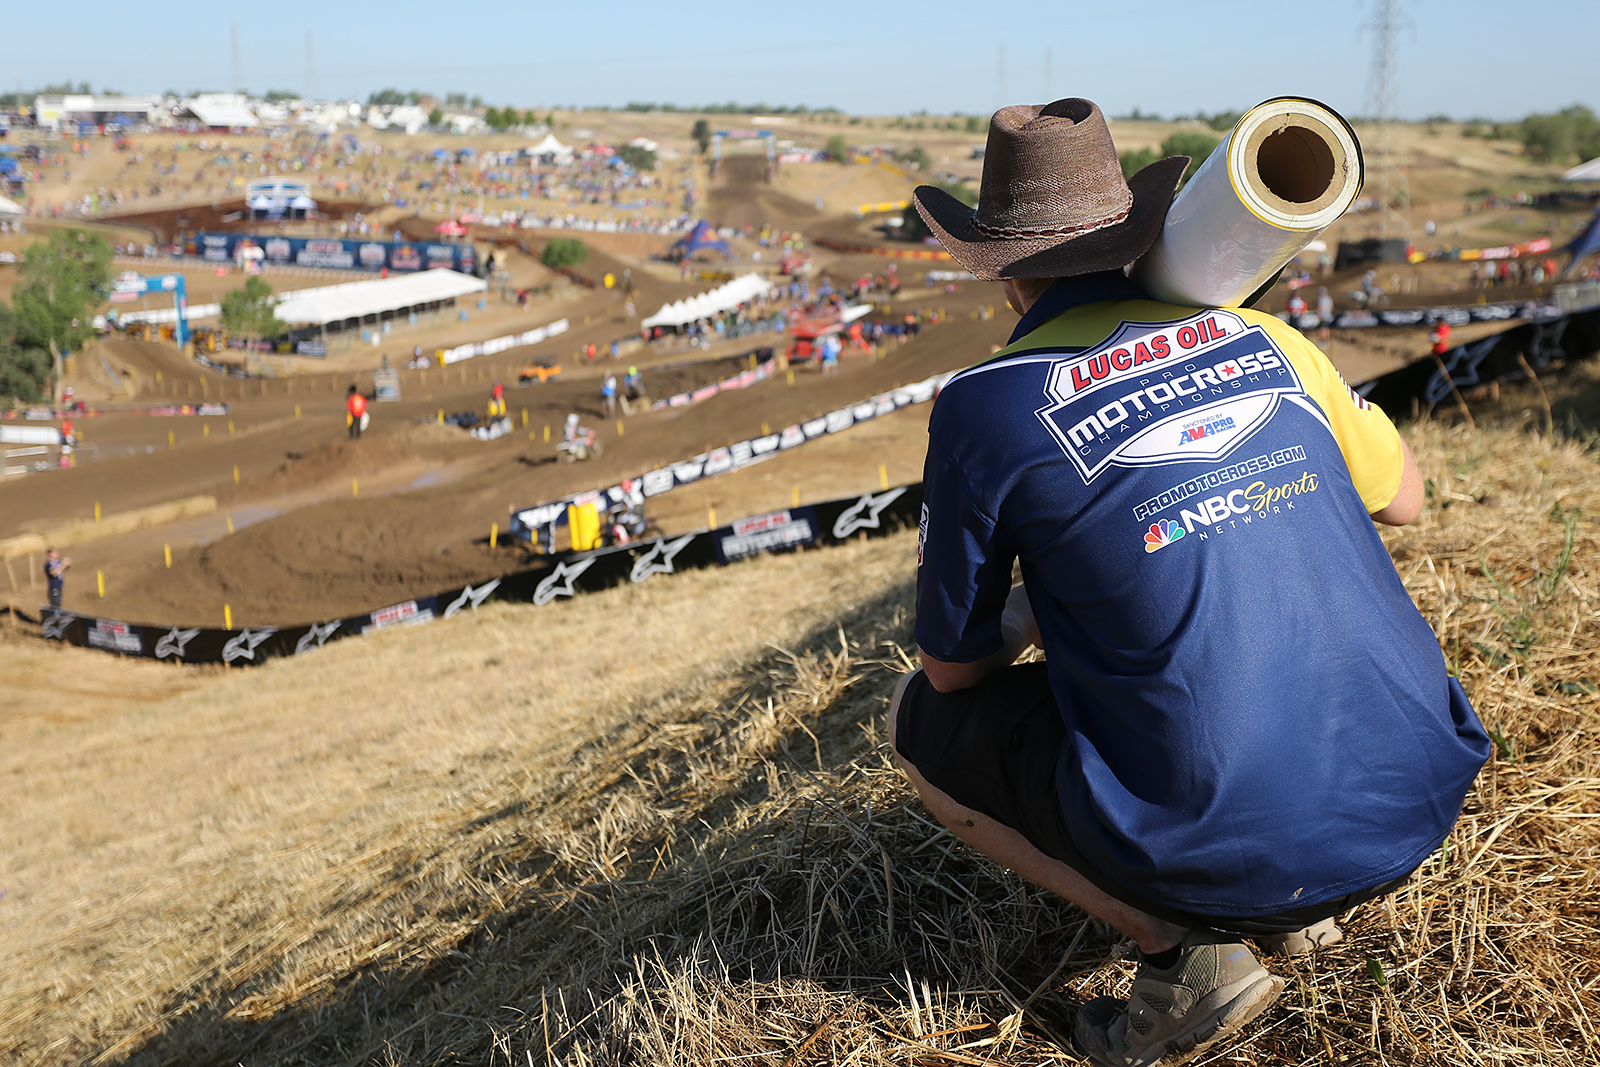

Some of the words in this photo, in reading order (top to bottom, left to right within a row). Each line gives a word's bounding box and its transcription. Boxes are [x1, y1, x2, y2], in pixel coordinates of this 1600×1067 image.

[1071, 334, 1171, 392] LUCAS
[1176, 317, 1227, 349] OIL
[1140, 363, 1198, 387] PRO
[1067, 349, 1282, 448] MOTOCROSS
[1081, 367, 1287, 457] CHAMPIONSHIP
[1183, 416, 1215, 429] SANCTIONED
[1178, 423, 1216, 446] AMA
[1212, 417, 1234, 429] PRO
[1216, 424, 1236, 433] RACING
[1133, 445, 1306, 522] PROMOTOCROSS.COM
[1180, 488, 1251, 533] NBC
[1244, 471, 1319, 513] Sports
[1199, 501, 1295, 541] NETWORK
